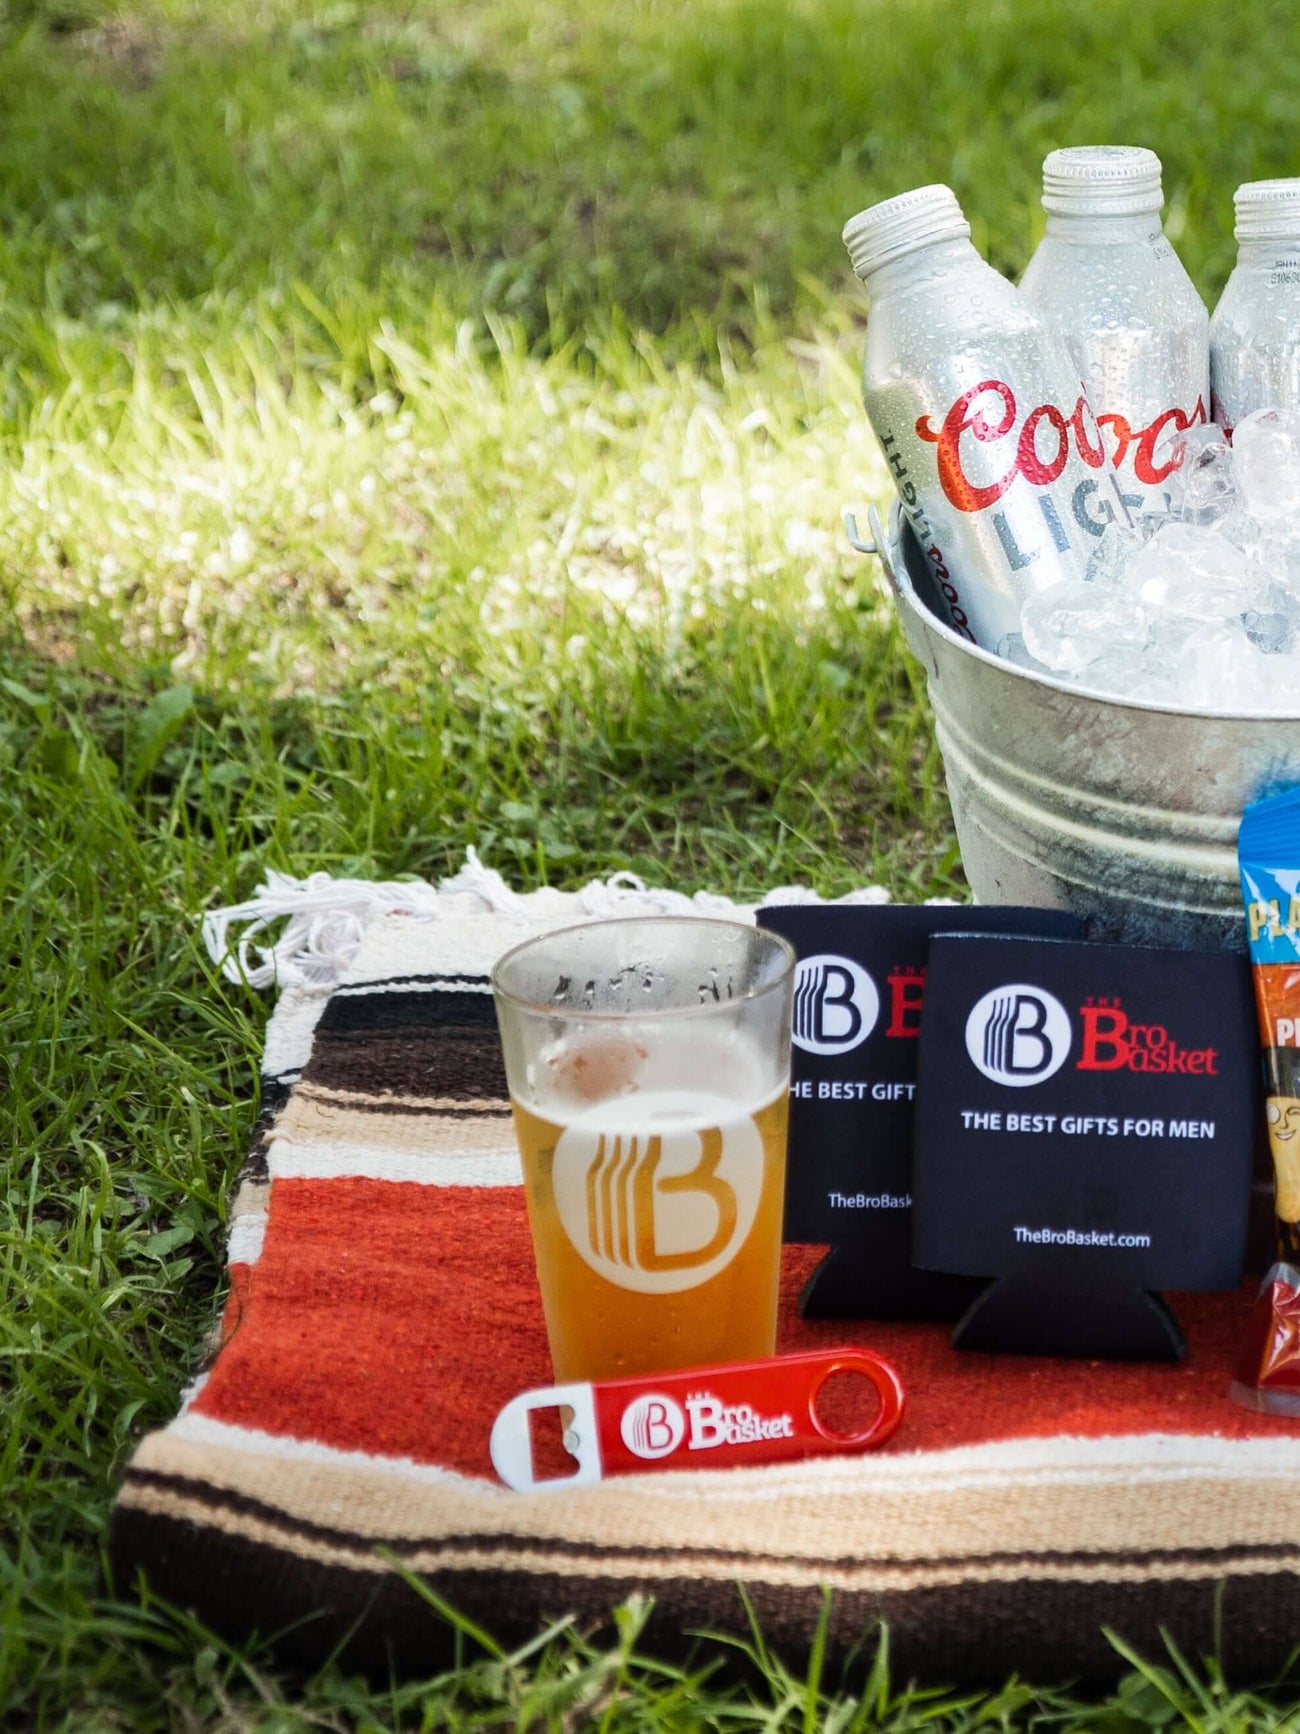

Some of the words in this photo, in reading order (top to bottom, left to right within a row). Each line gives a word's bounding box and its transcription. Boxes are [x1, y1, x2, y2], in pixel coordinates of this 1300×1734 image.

[818, 1082, 867, 1100] BEST
[871, 1084, 917, 1101] GIFT
[961, 1111, 1001, 1131] THE
[1005, 1113, 1057, 1133] BEST
[1060, 1116, 1120, 1136] GIFTS
[1123, 1119, 1165, 1138] FOR
[1168, 1121, 1216, 1139] MEN
[1013, 1226, 1151, 1248] TheBroBasket.com
